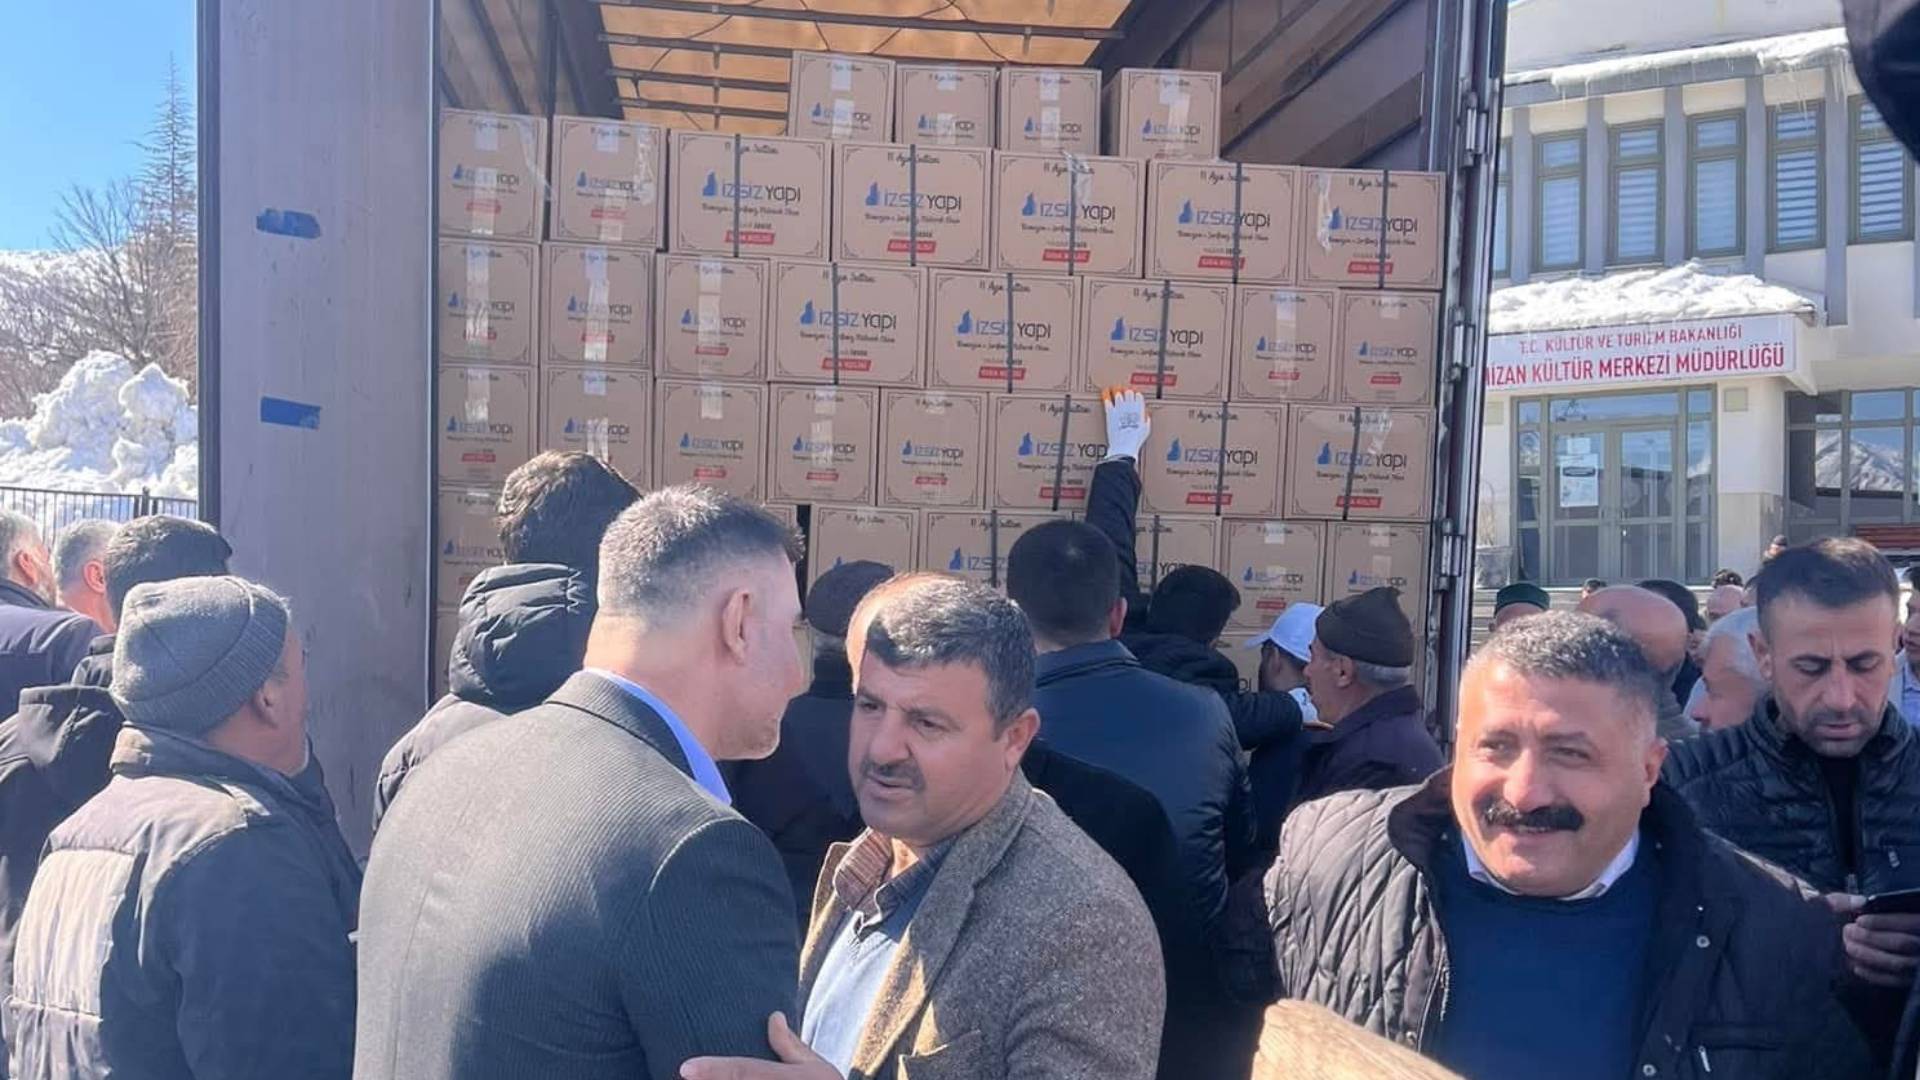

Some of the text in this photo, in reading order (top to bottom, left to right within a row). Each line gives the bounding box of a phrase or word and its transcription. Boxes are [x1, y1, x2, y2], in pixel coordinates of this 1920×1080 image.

[1545, 334, 1594, 353] KÜLTÜR
[1599, 334, 1613, 348] VE
[1532, 356, 1593, 382] KÜLTÜR
[1599, 349, 1670, 378] MERKEZİ
[1676, 341, 1784, 373] MÜDÜRLÜĞÜ
